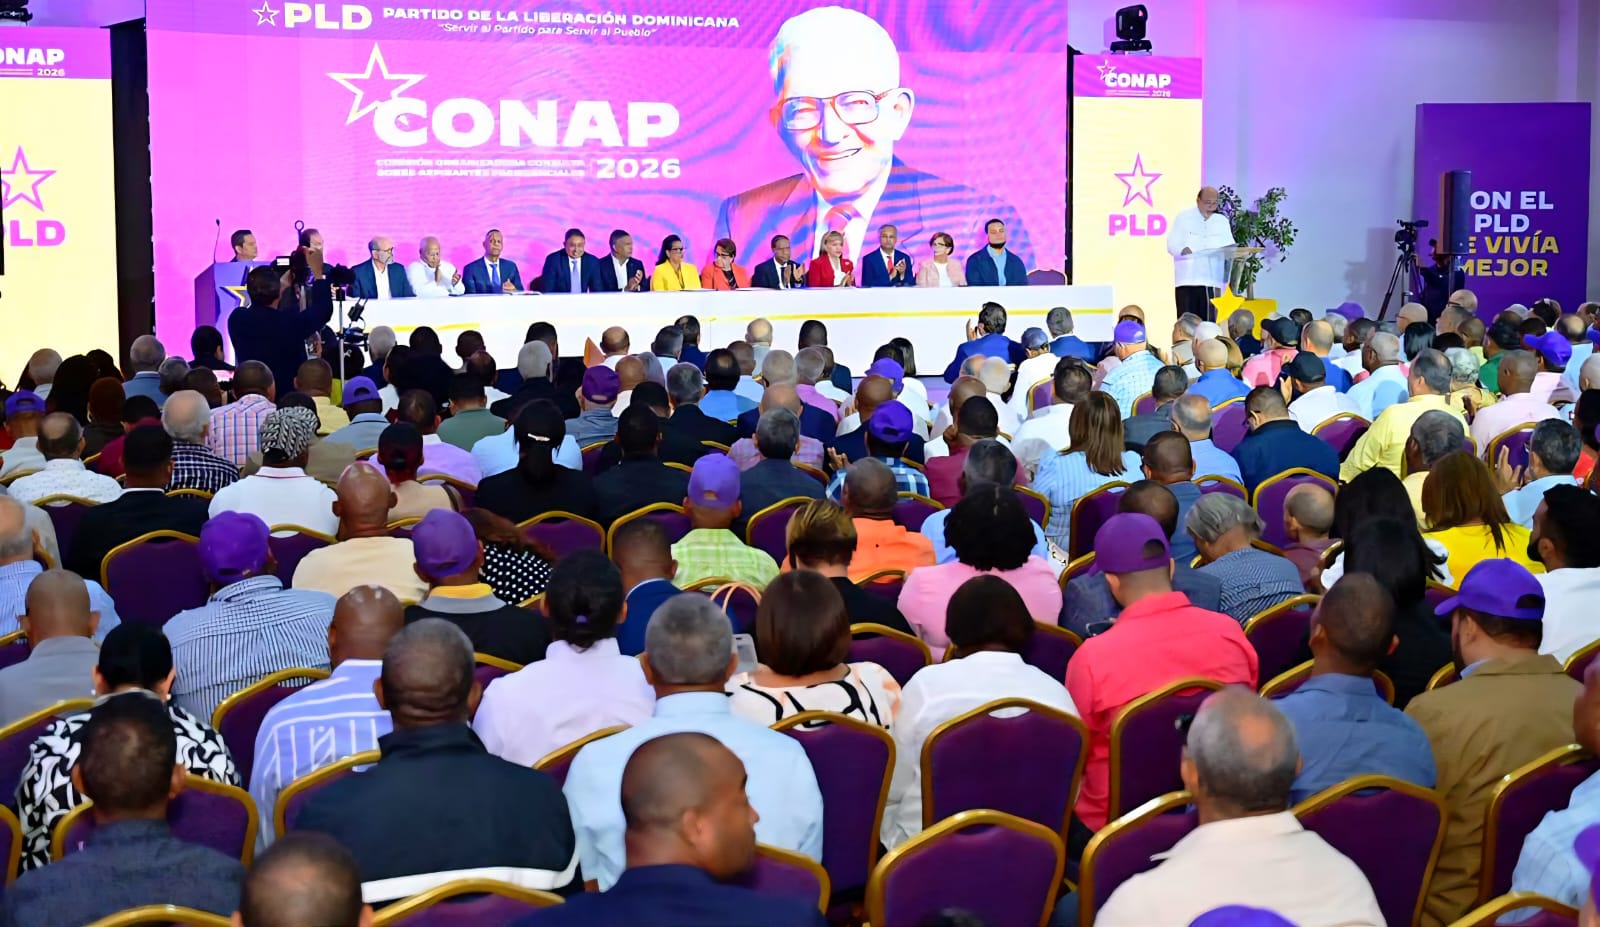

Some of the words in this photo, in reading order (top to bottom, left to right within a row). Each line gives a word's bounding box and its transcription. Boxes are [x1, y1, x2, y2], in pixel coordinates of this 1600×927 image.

[284, 2, 373, 30] PLD
[383, 7, 463, 20] PARTIDO
[468, 10, 493, 21] DE
[496, 11, 519, 22] LA
[524, 11, 627, 25] LIBERACIÓN
[632, 14, 739, 28] DOMINICANA
[481, 24, 491, 33] al
[494, 24, 535, 34] Partido
[538, 26, 563, 36] para
[566, 26, 598, 36] Servir
[601, 27, 611, 36] al
[0, 47, 65, 66] NAP
[1105, 73, 1171, 88] CONAP
[373, 97, 680, 147] CONAP
[596, 158, 681, 179] 2026
[1470, 191, 1512, 210] ON
[1520, 191, 1554, 210] EL
[4, 220, 66, 247] LD
[1109, 214, 1167, 236] PLD
[1474, 213, 1530, 233] PLD
[1485, 230, 1559, 254] VIVÍA
